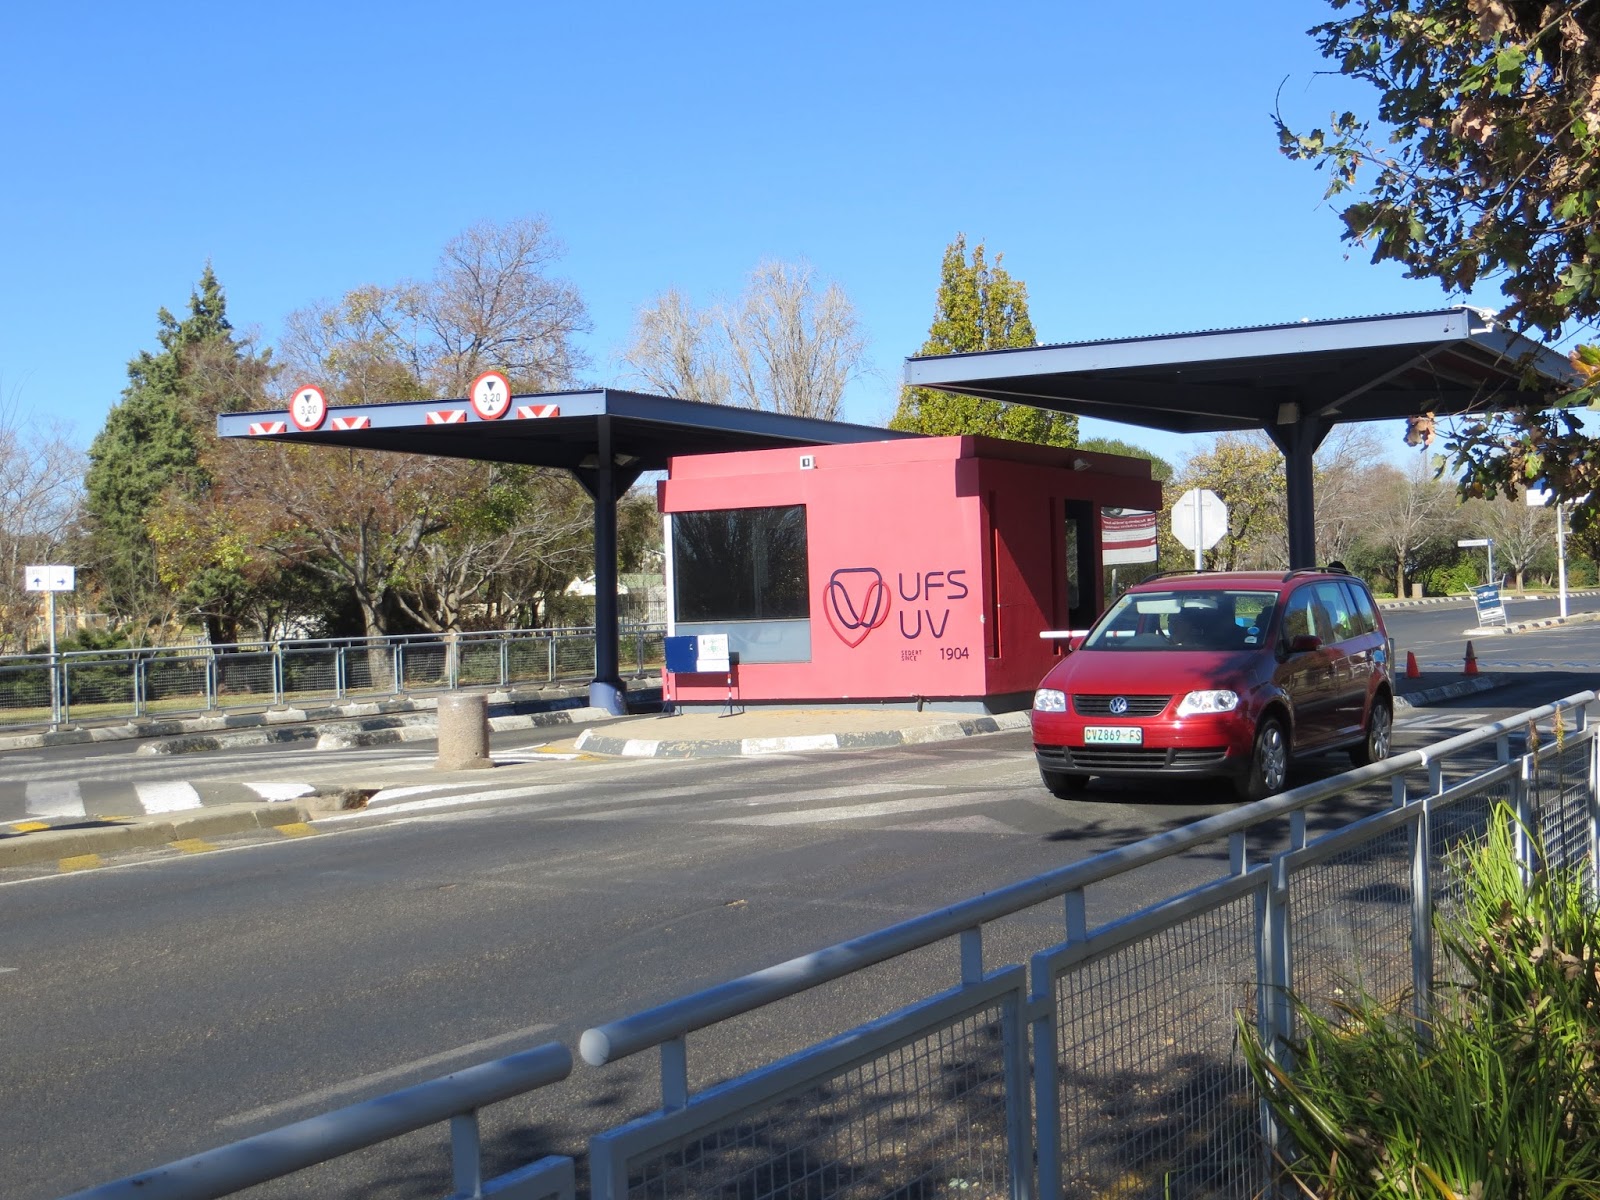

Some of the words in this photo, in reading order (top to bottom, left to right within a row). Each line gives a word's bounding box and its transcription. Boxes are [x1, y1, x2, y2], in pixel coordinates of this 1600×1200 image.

[899, 570, 968, 601] UFS
[899, 609, 950, 639] UV
[939, 647, 969, 661] 1904
[1085, 729, 1121, 741] CVZ869
[1129, 729, 1141, 741] FS
